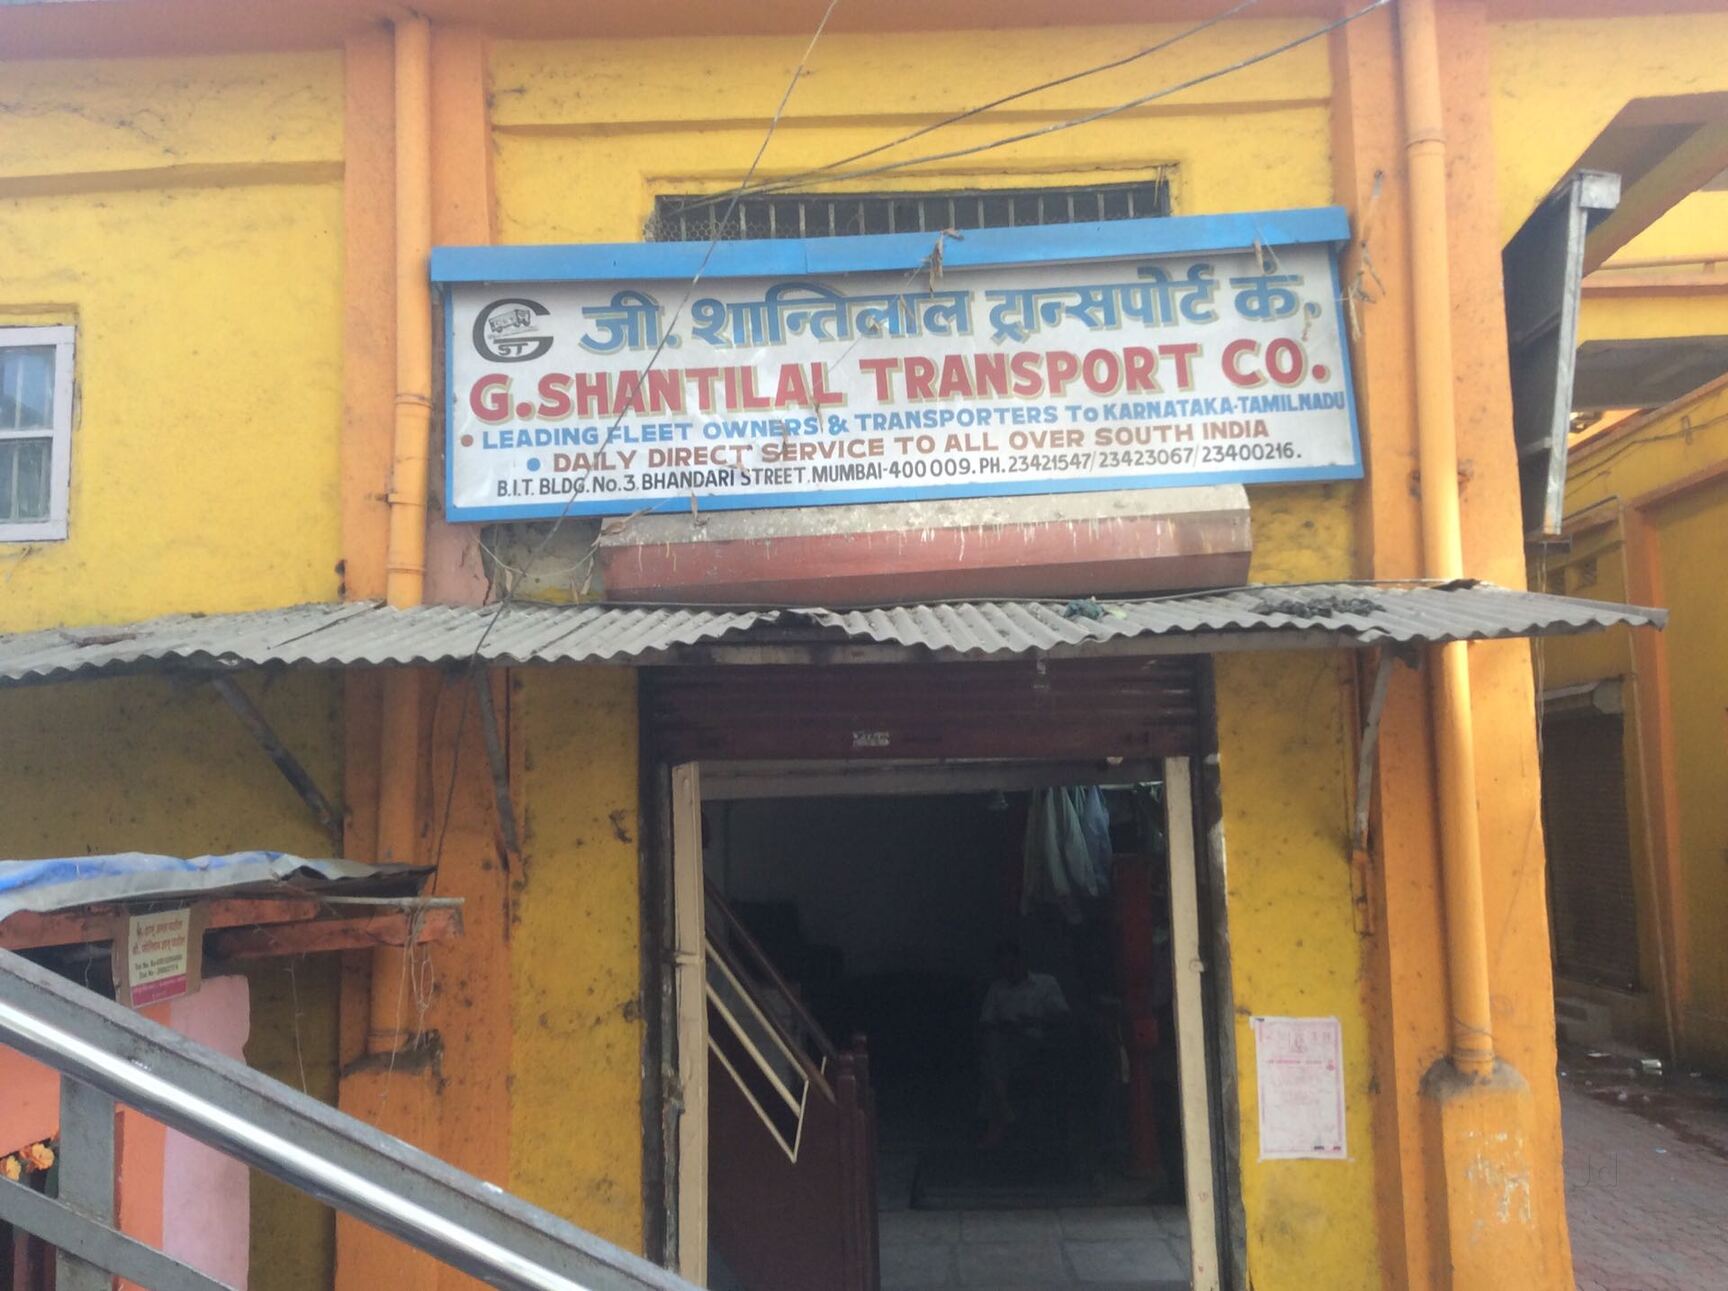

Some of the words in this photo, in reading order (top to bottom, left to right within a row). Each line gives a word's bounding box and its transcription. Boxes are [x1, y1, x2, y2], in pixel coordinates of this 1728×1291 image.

[860, 343, 1203, 405] TRANSPORT
[1221, 338, 1332, 389] CO.
[482, 426, 599, 450] LEADING
[607, 423, 694, 444] FLEET
[703, 415, 819, 442] OWNERS
[828, 414, 850, 436] &
[855, 406, 1059, 431] TRANSPORTERS
[554, 450, 638, 473] DAILY
[648, 445, 752, 469] DIRECT
[761, 438, 884, 463] SERVICE
[894, 436, 935, 455] TO
[944, 433, 999, 453] ALL
[1009, 429, 1084, 450] OVER
[1095, 423, 1193, 447] SOUTH
[1203, 419, 1270, 441] INDIA
[497, 479, 534, 498] B.I.T.
